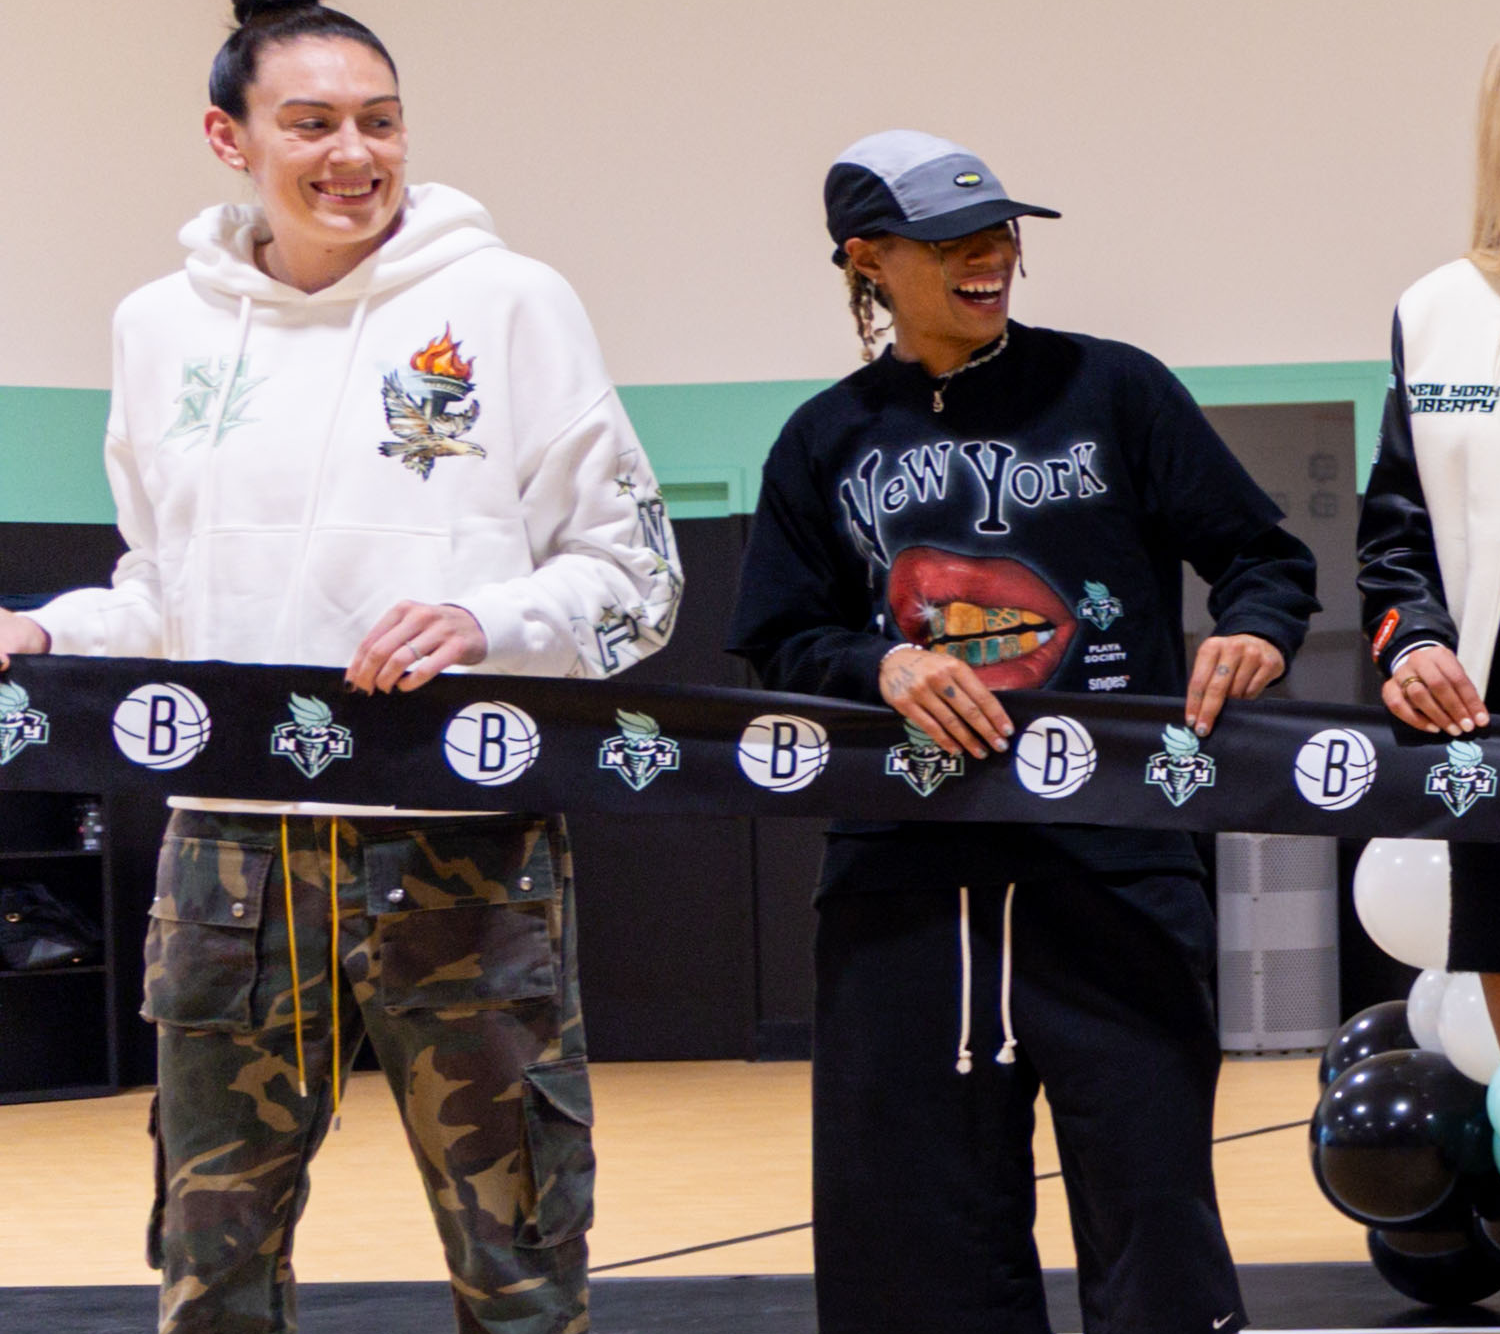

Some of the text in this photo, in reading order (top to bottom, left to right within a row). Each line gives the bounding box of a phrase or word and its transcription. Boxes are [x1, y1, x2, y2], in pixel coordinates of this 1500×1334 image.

[1407, 383, 1446, 396] NEW
[147, 695, 178, 757] B
[478, 712, 507, 773] B
[770, 721, 799, 780] B
[1042, 727, 1069, 786] B
[1322, 739, 1350, 798] B
